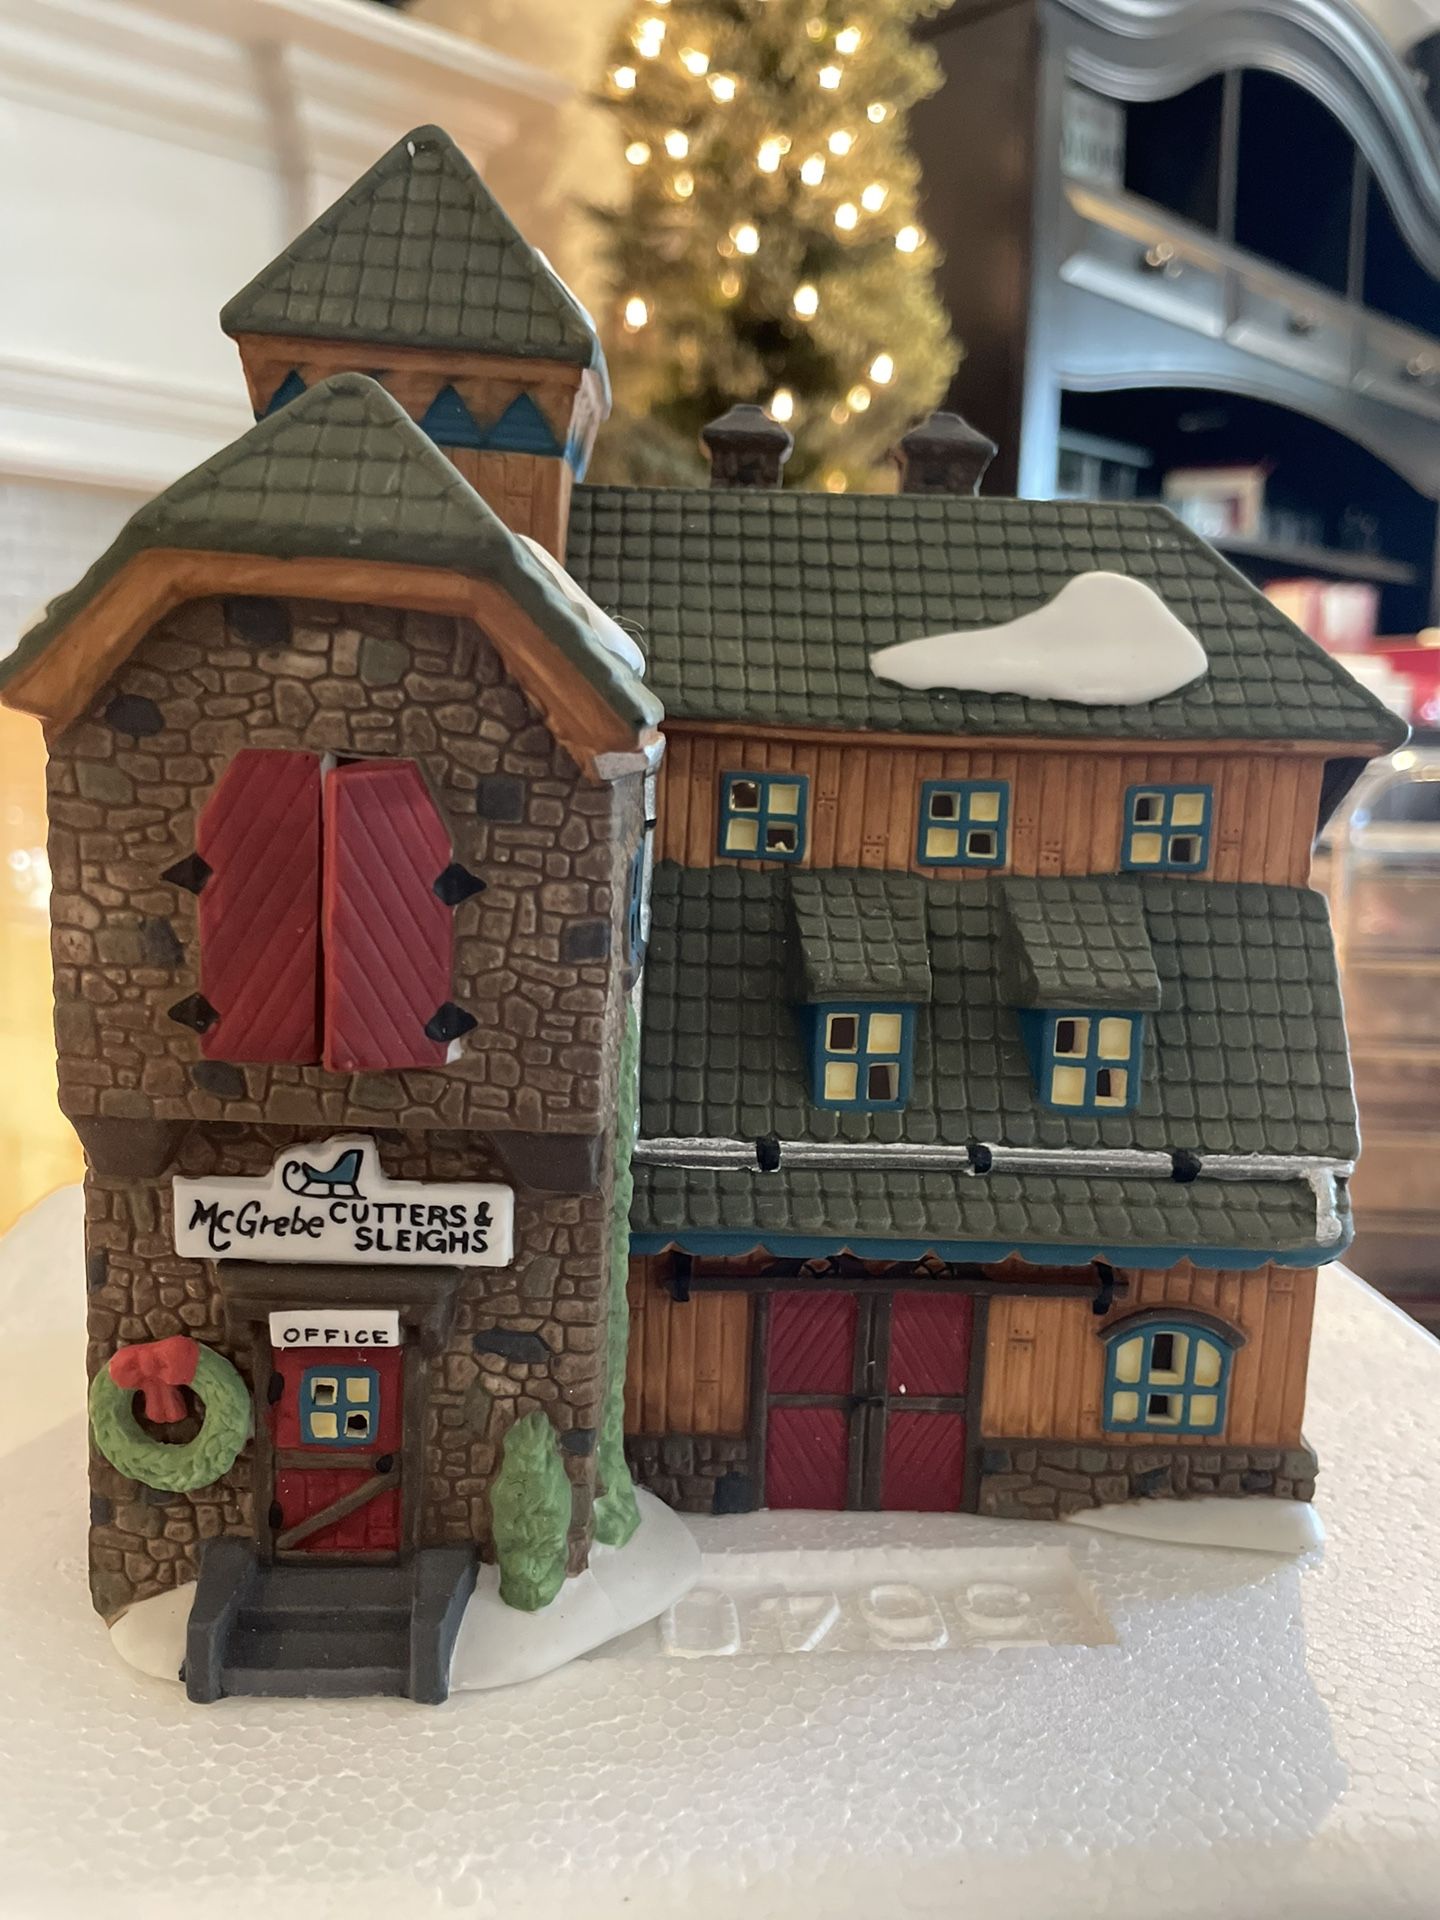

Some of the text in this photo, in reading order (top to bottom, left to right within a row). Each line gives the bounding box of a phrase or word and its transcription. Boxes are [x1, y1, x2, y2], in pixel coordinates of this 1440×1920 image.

[189, 1200, 324, 1251] McGrebe
[329, 1201, 493, 1230] CUTTERS &
[354, 1227, 489, 1254] SLEIGHS
[283, 1328, 389, 1345] OFFICE
